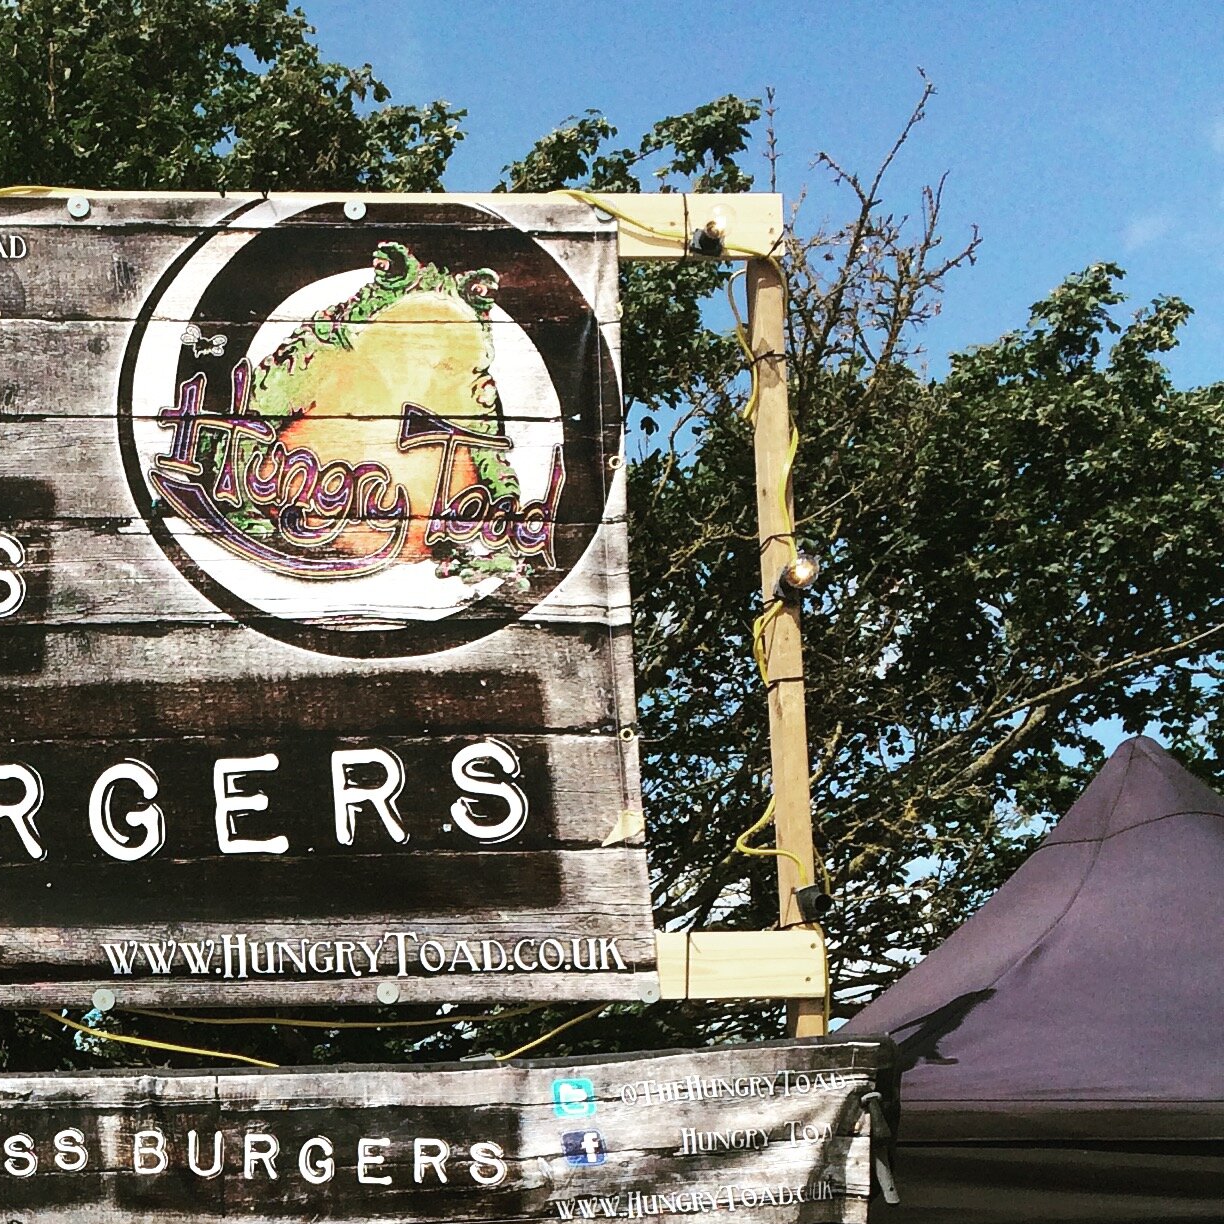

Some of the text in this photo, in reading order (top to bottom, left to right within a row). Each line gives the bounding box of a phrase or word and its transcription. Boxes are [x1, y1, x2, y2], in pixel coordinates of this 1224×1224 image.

[399, 402, 566, 569] Toad
[101, 931, 628, 980] WWW.HUNGRYTOAD.CO.UK
[132, 1128, 512, 1187] BURGERS
[680, 1120, 834, 1155] HUNGRY TOA
